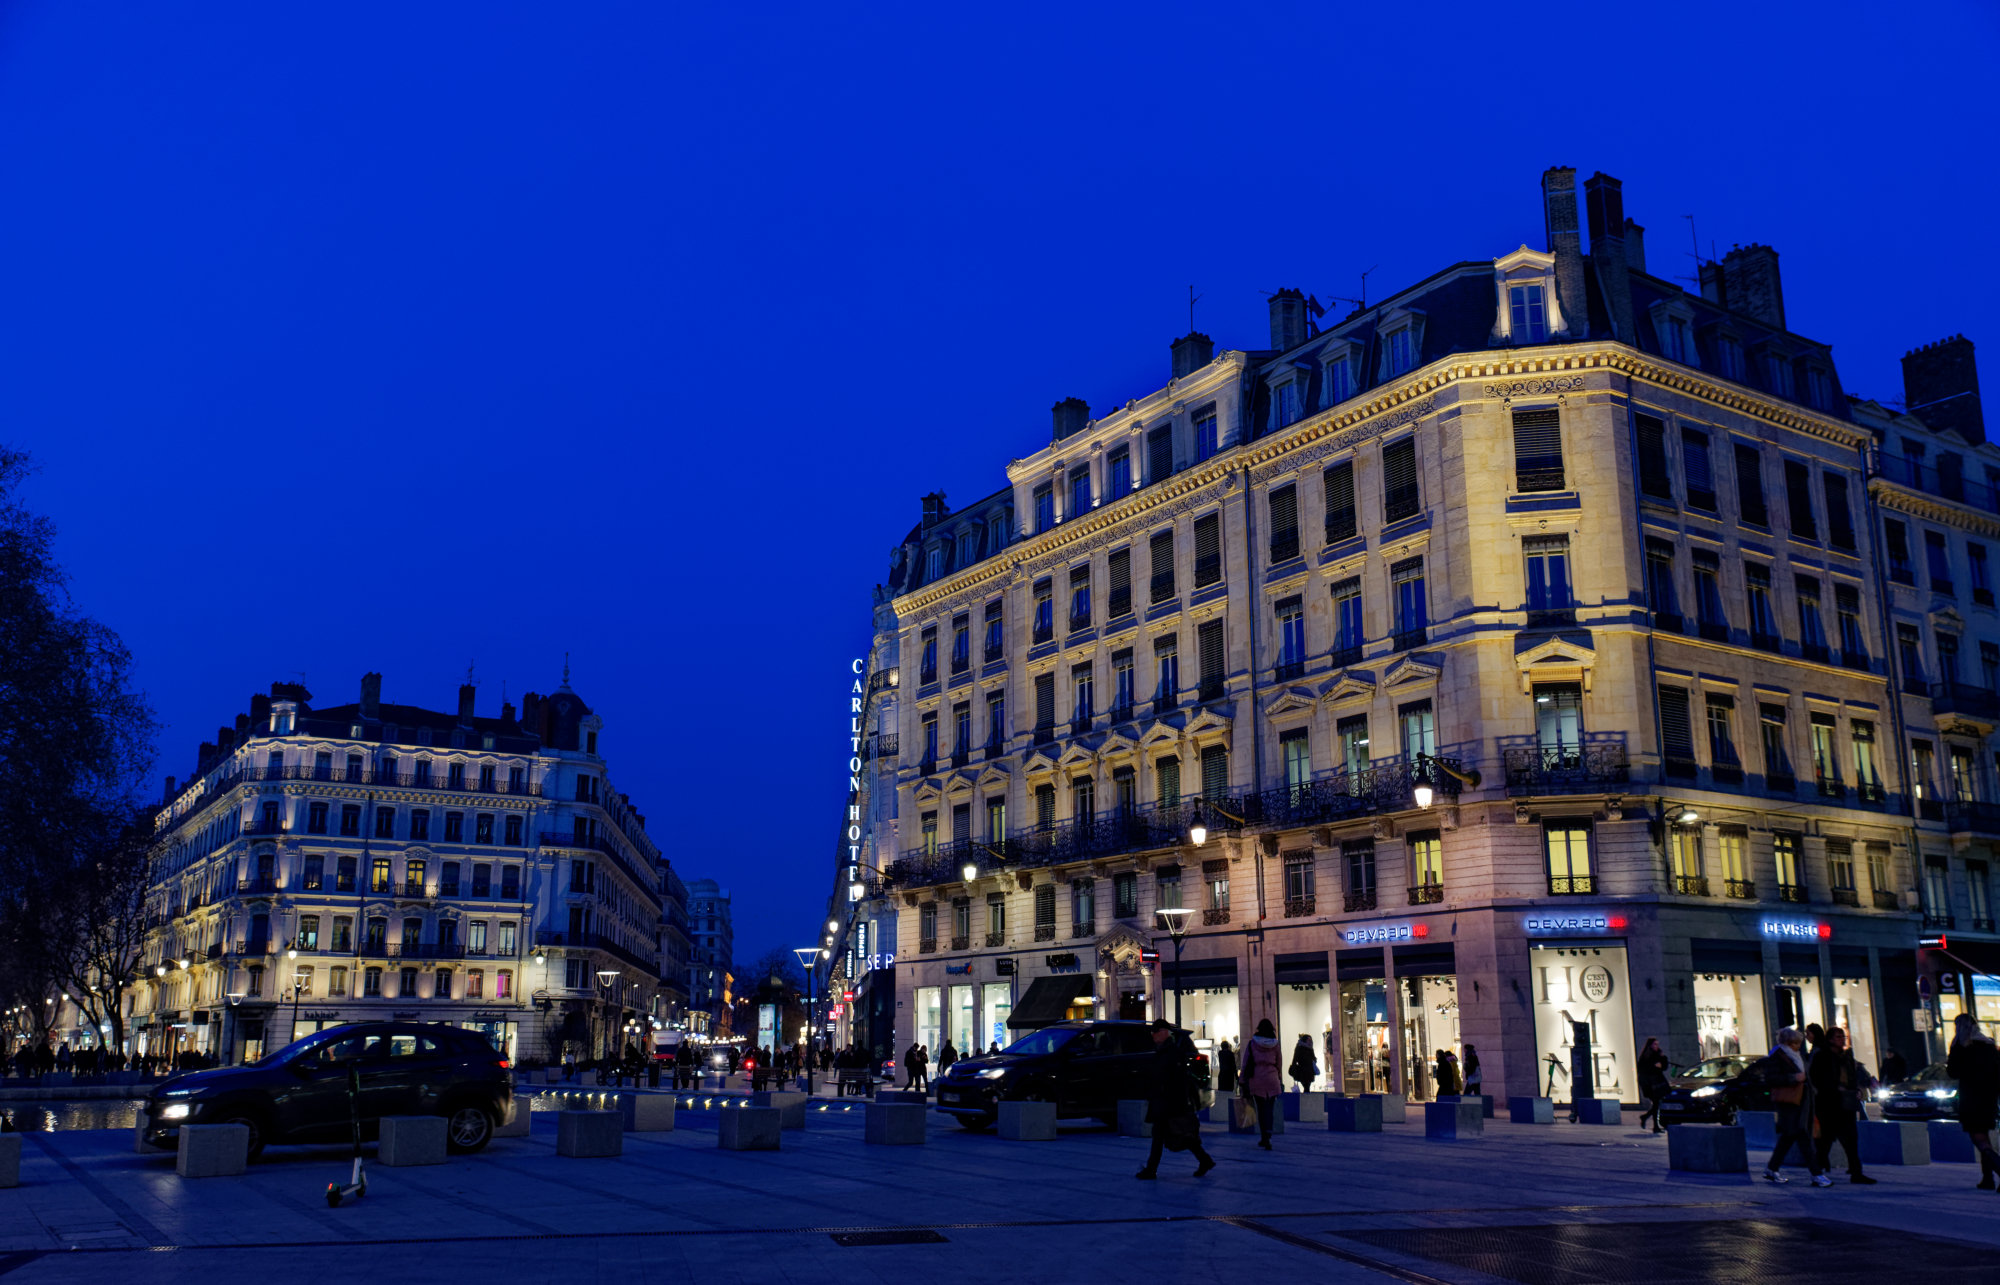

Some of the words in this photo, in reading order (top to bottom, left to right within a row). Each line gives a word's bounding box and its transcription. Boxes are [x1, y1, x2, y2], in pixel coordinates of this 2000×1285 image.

[850, 658, 862, 792] CARLTON
[1527, 918, 1606, 929] DEVRED
[1346, 926, 1411, 941] DEVRED
[1587, 981, 1607, 989] BEAU
[1591, 988, 1604, 996] UN
